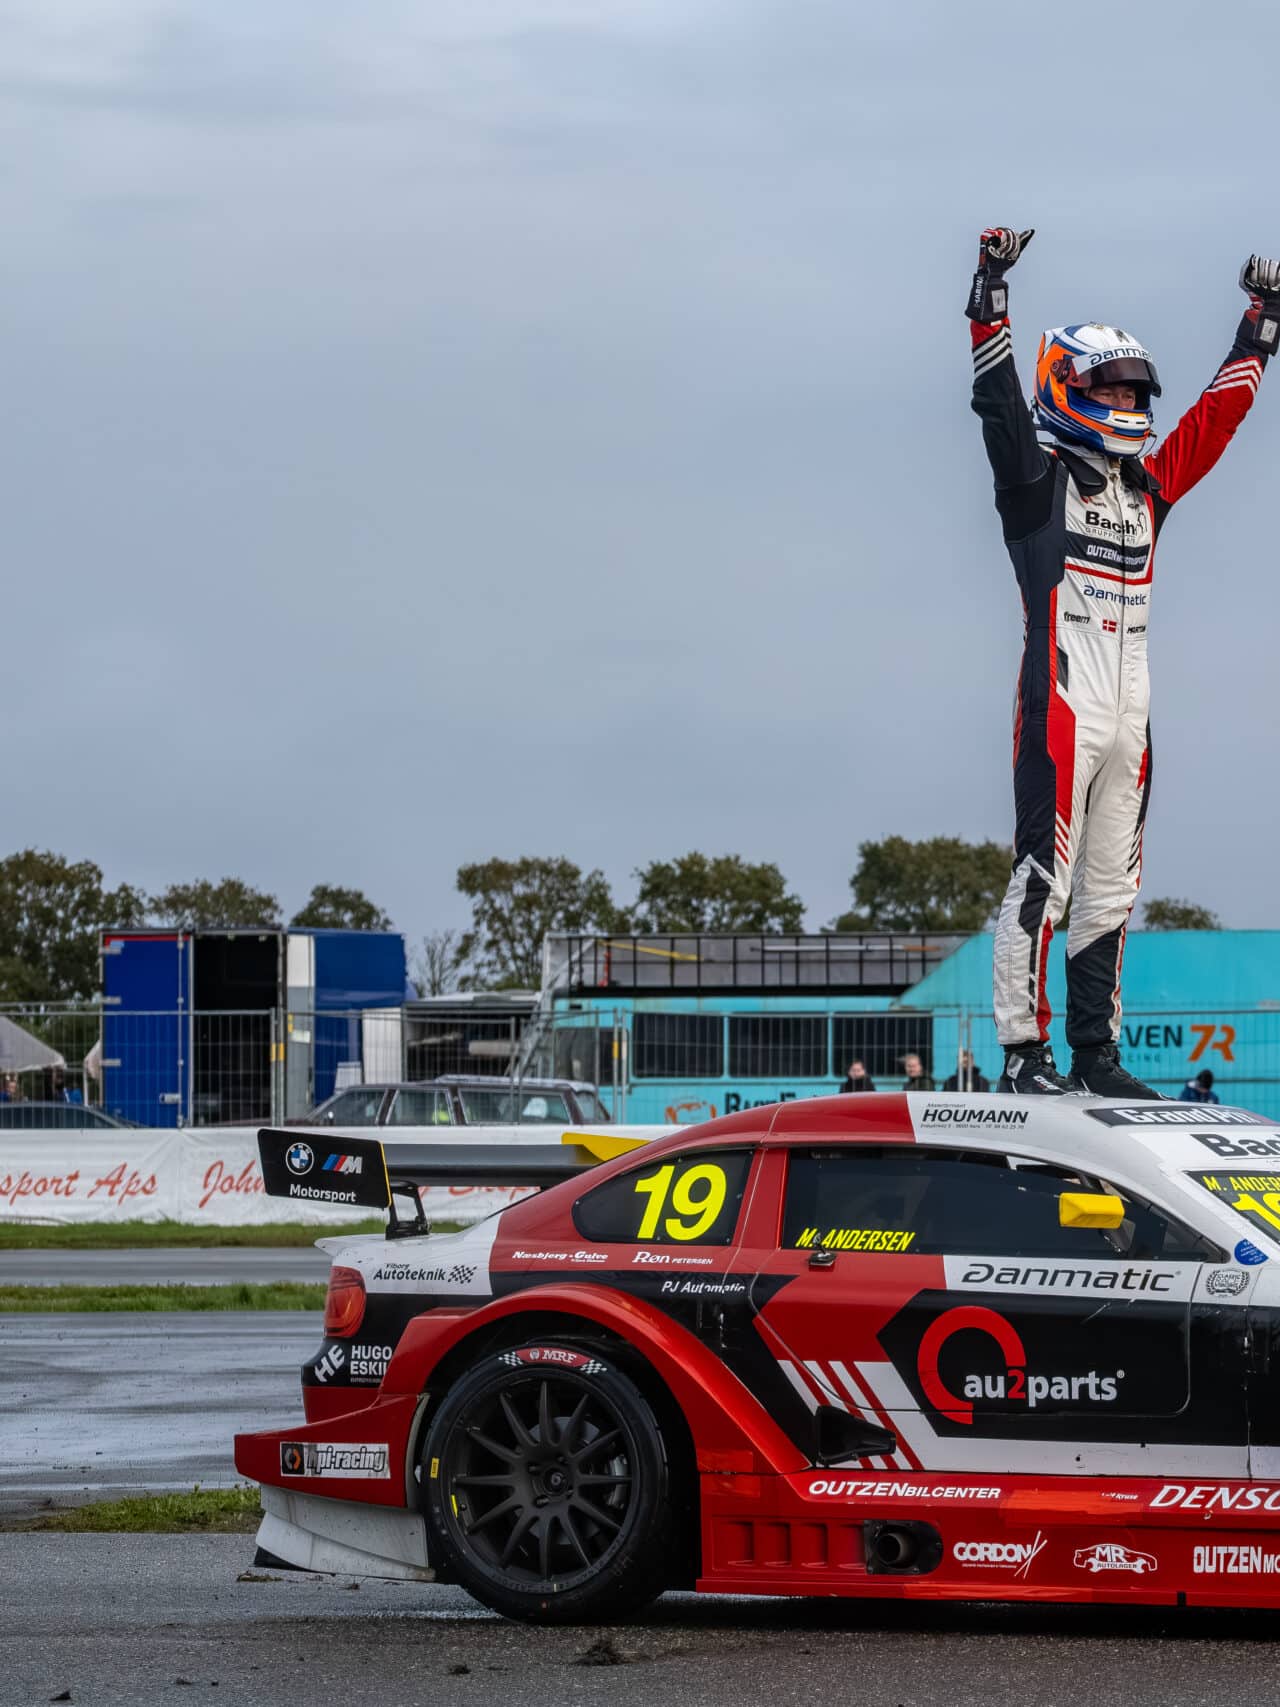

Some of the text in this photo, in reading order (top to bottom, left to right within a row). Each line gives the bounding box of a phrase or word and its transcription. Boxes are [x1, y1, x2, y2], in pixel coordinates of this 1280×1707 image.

[922, 1109, 1029, 1123] HOUMANN
[1114, 1108, 1212, 1124] Grand
[87, 1162, 158, 1206] Aps
[1203, 1176, 1227, 1191] M.
[290, 1184, 356, 1203] Motorsport
[635, 1163, 727, 1241] 19
[795, 1227, 916, 1251] M. ANDERSEN
[373, 1268, 445, 1281] Autoteknik
[962, 1263, 1175, 1292] Danmatic
[661, 1281, 680, 1294] PJ
[351, 1345, 393, 1360] HUGO
[542, 1350, 577, 1364] MRF
[1095, 1546, 1128, 1563] MR
